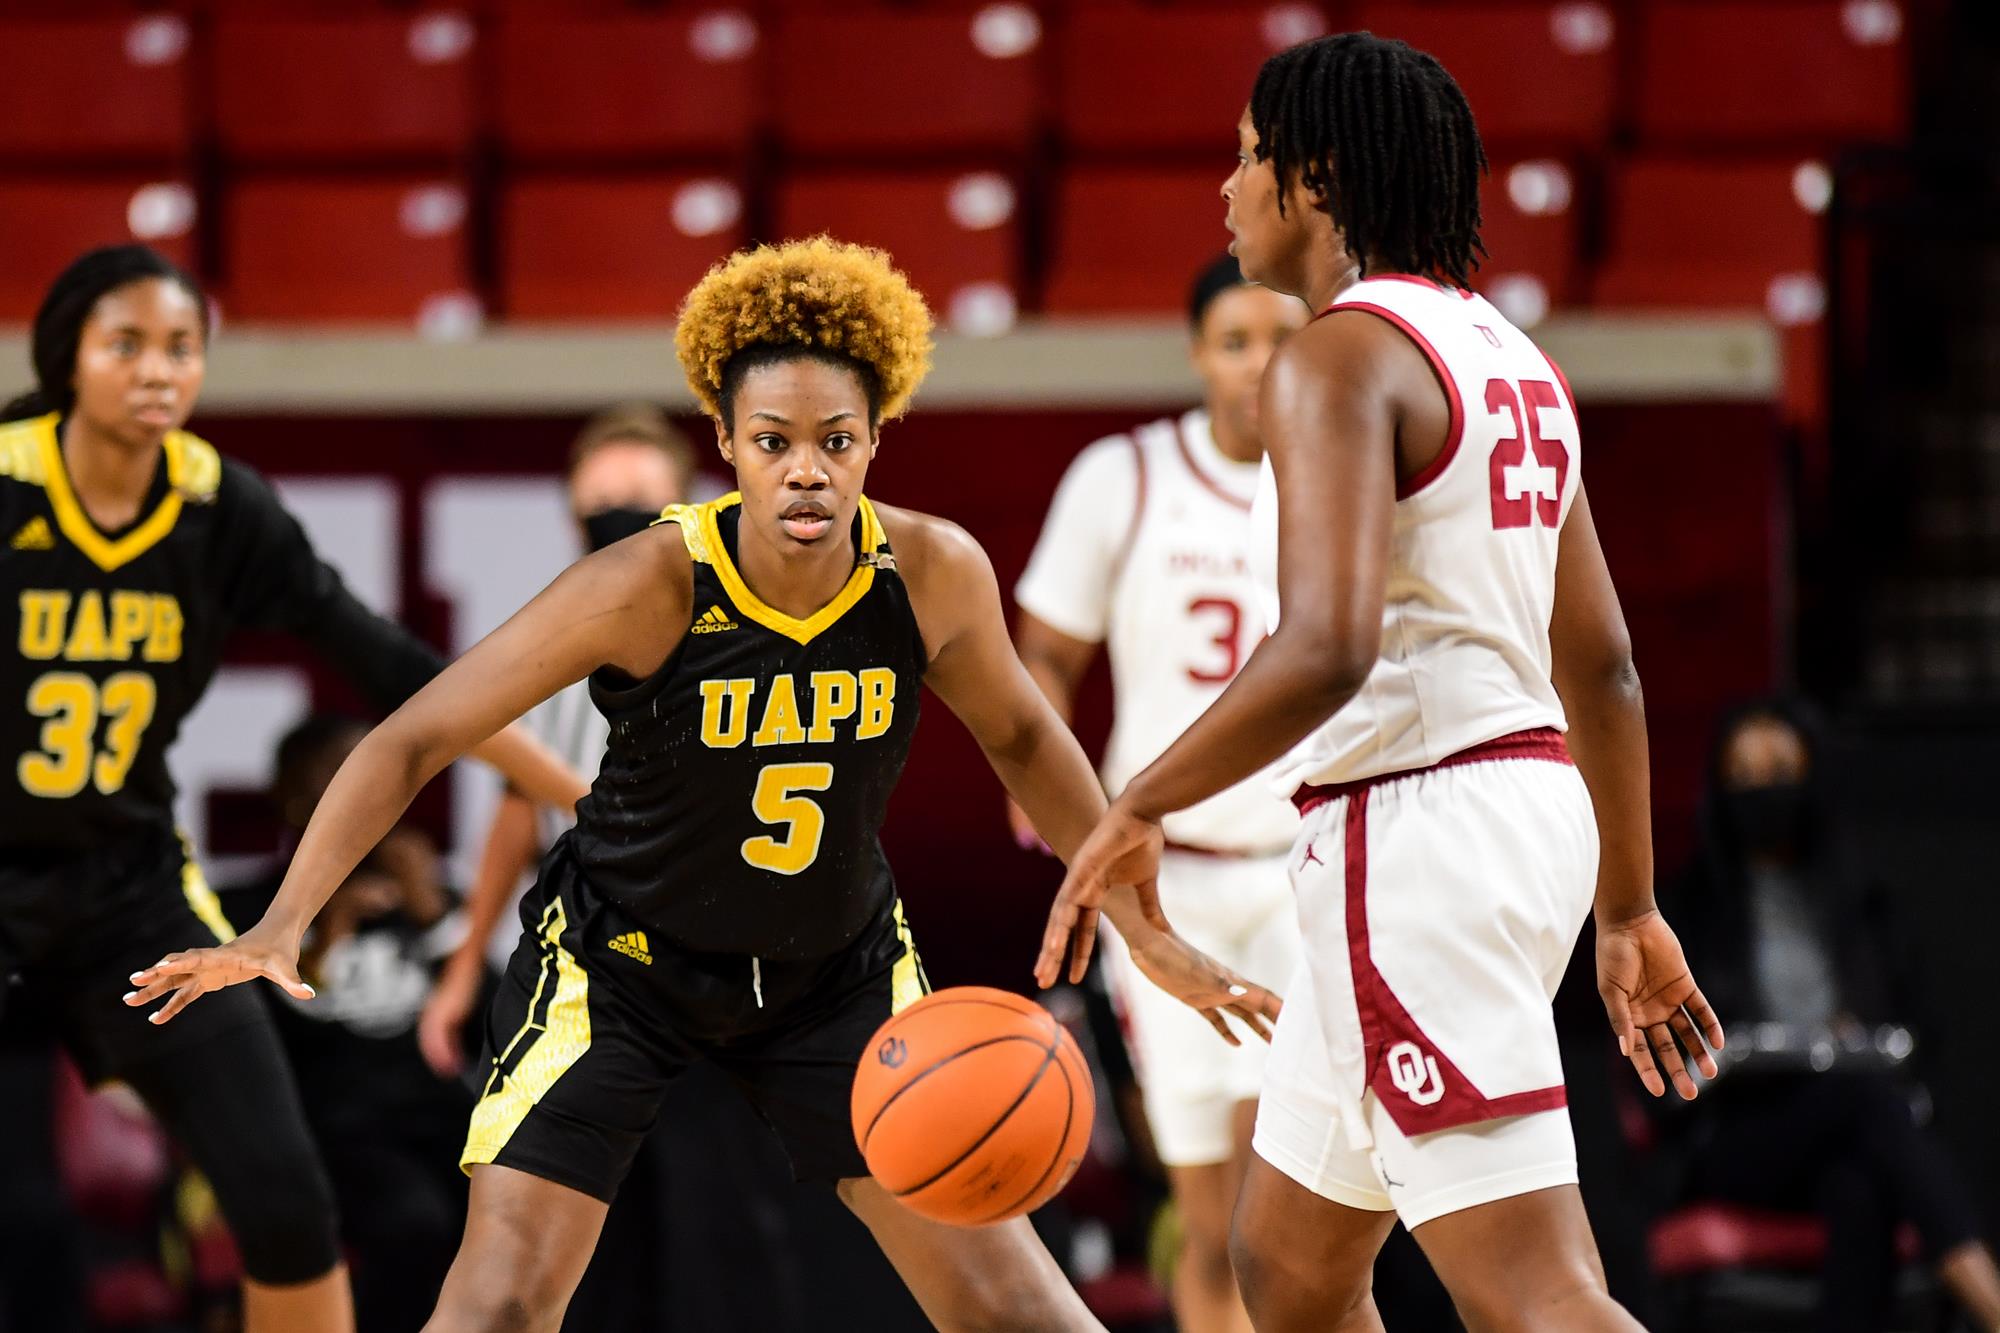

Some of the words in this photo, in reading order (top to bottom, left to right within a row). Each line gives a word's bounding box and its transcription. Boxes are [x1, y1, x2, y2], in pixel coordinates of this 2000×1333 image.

[1484, 378, 1569, 530] 25
[18, 588, 185, 662] UAPB
[691, 622, 739, 635] adidas
[1184, 595, 1242, 685] 3
[17, 670, 157, 798] 33
[700, 667, 896, 748] UAPB
[740, 762, 834, 876] 5
[607, 938, 653, 966] adidas
[1386, 1040, 1446, 1106] OU
